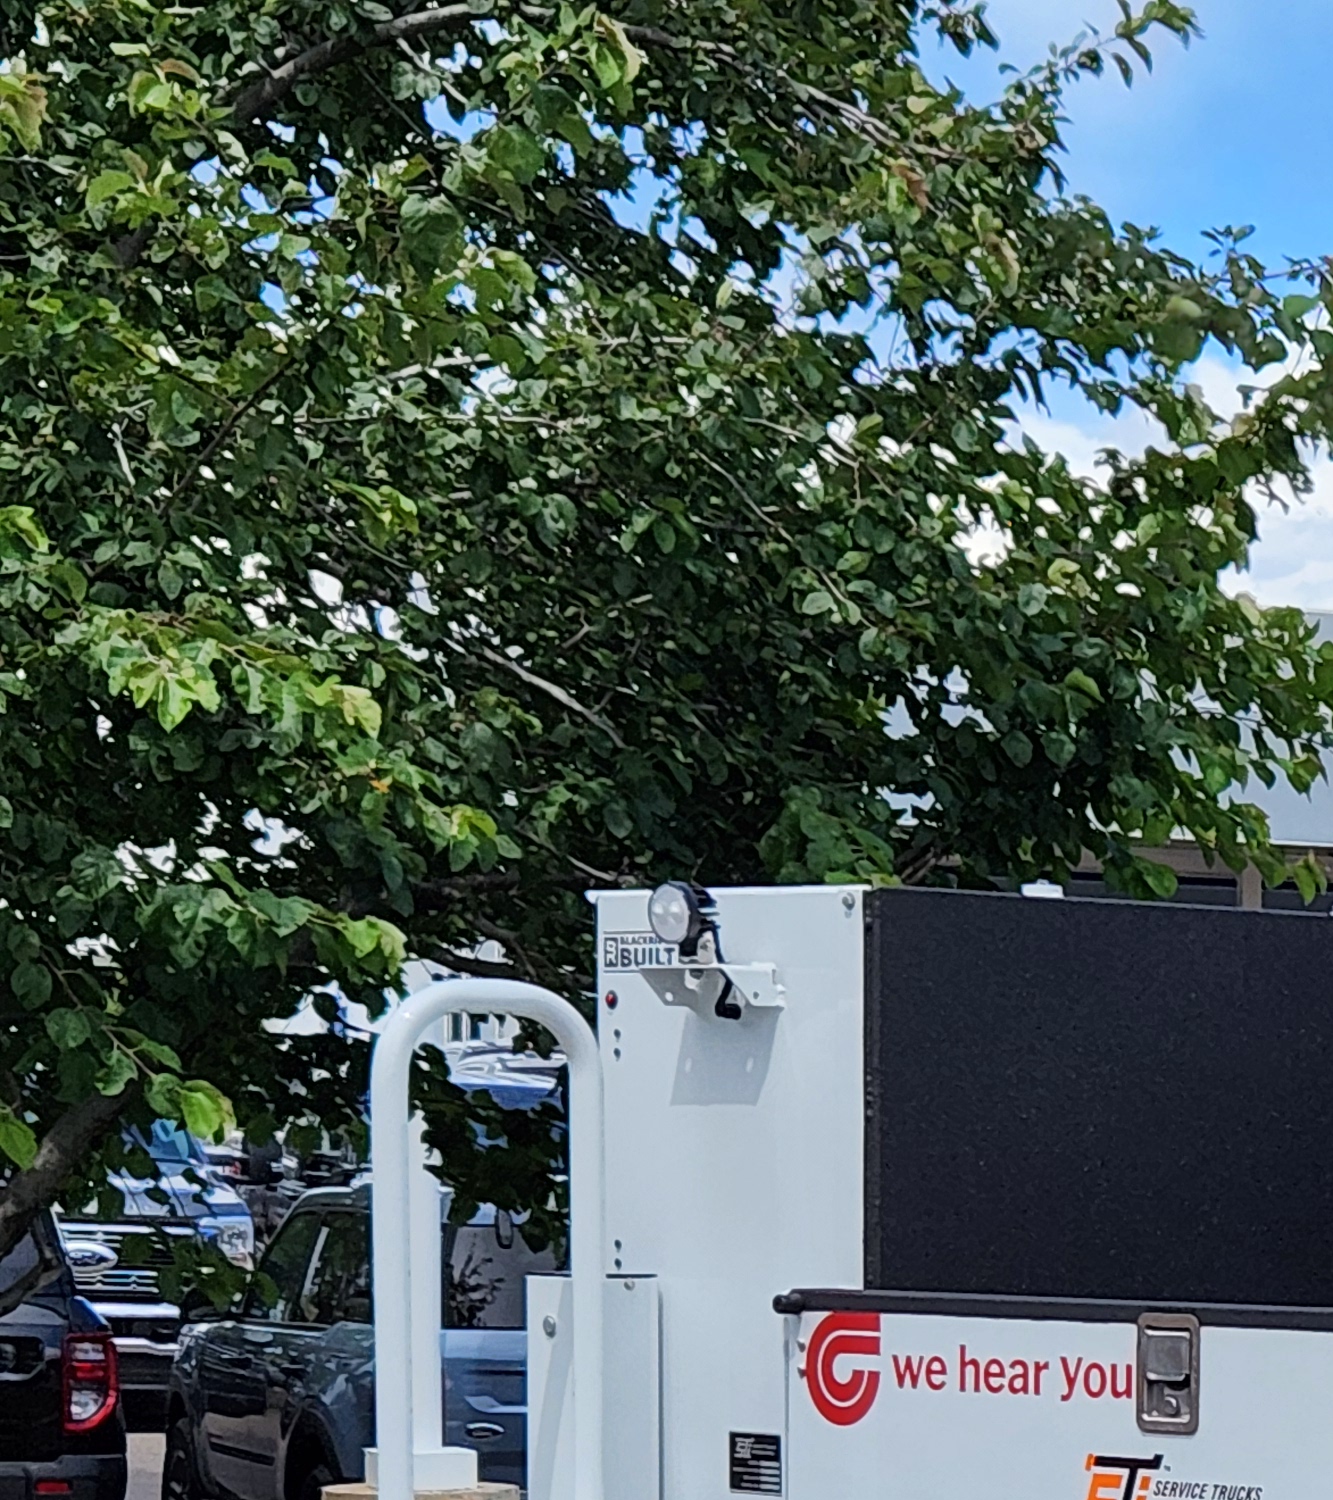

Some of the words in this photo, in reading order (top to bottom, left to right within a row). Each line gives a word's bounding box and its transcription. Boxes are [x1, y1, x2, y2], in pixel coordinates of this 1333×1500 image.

[620, 947, 676, 968] BUILT
[891, 1354, 948, 1391] we
[959, 1344, 1050, 1396] hear
[1059, 1356, 1133, 1402] you
[1152, 1480, 1209, 1500] SERVICE
